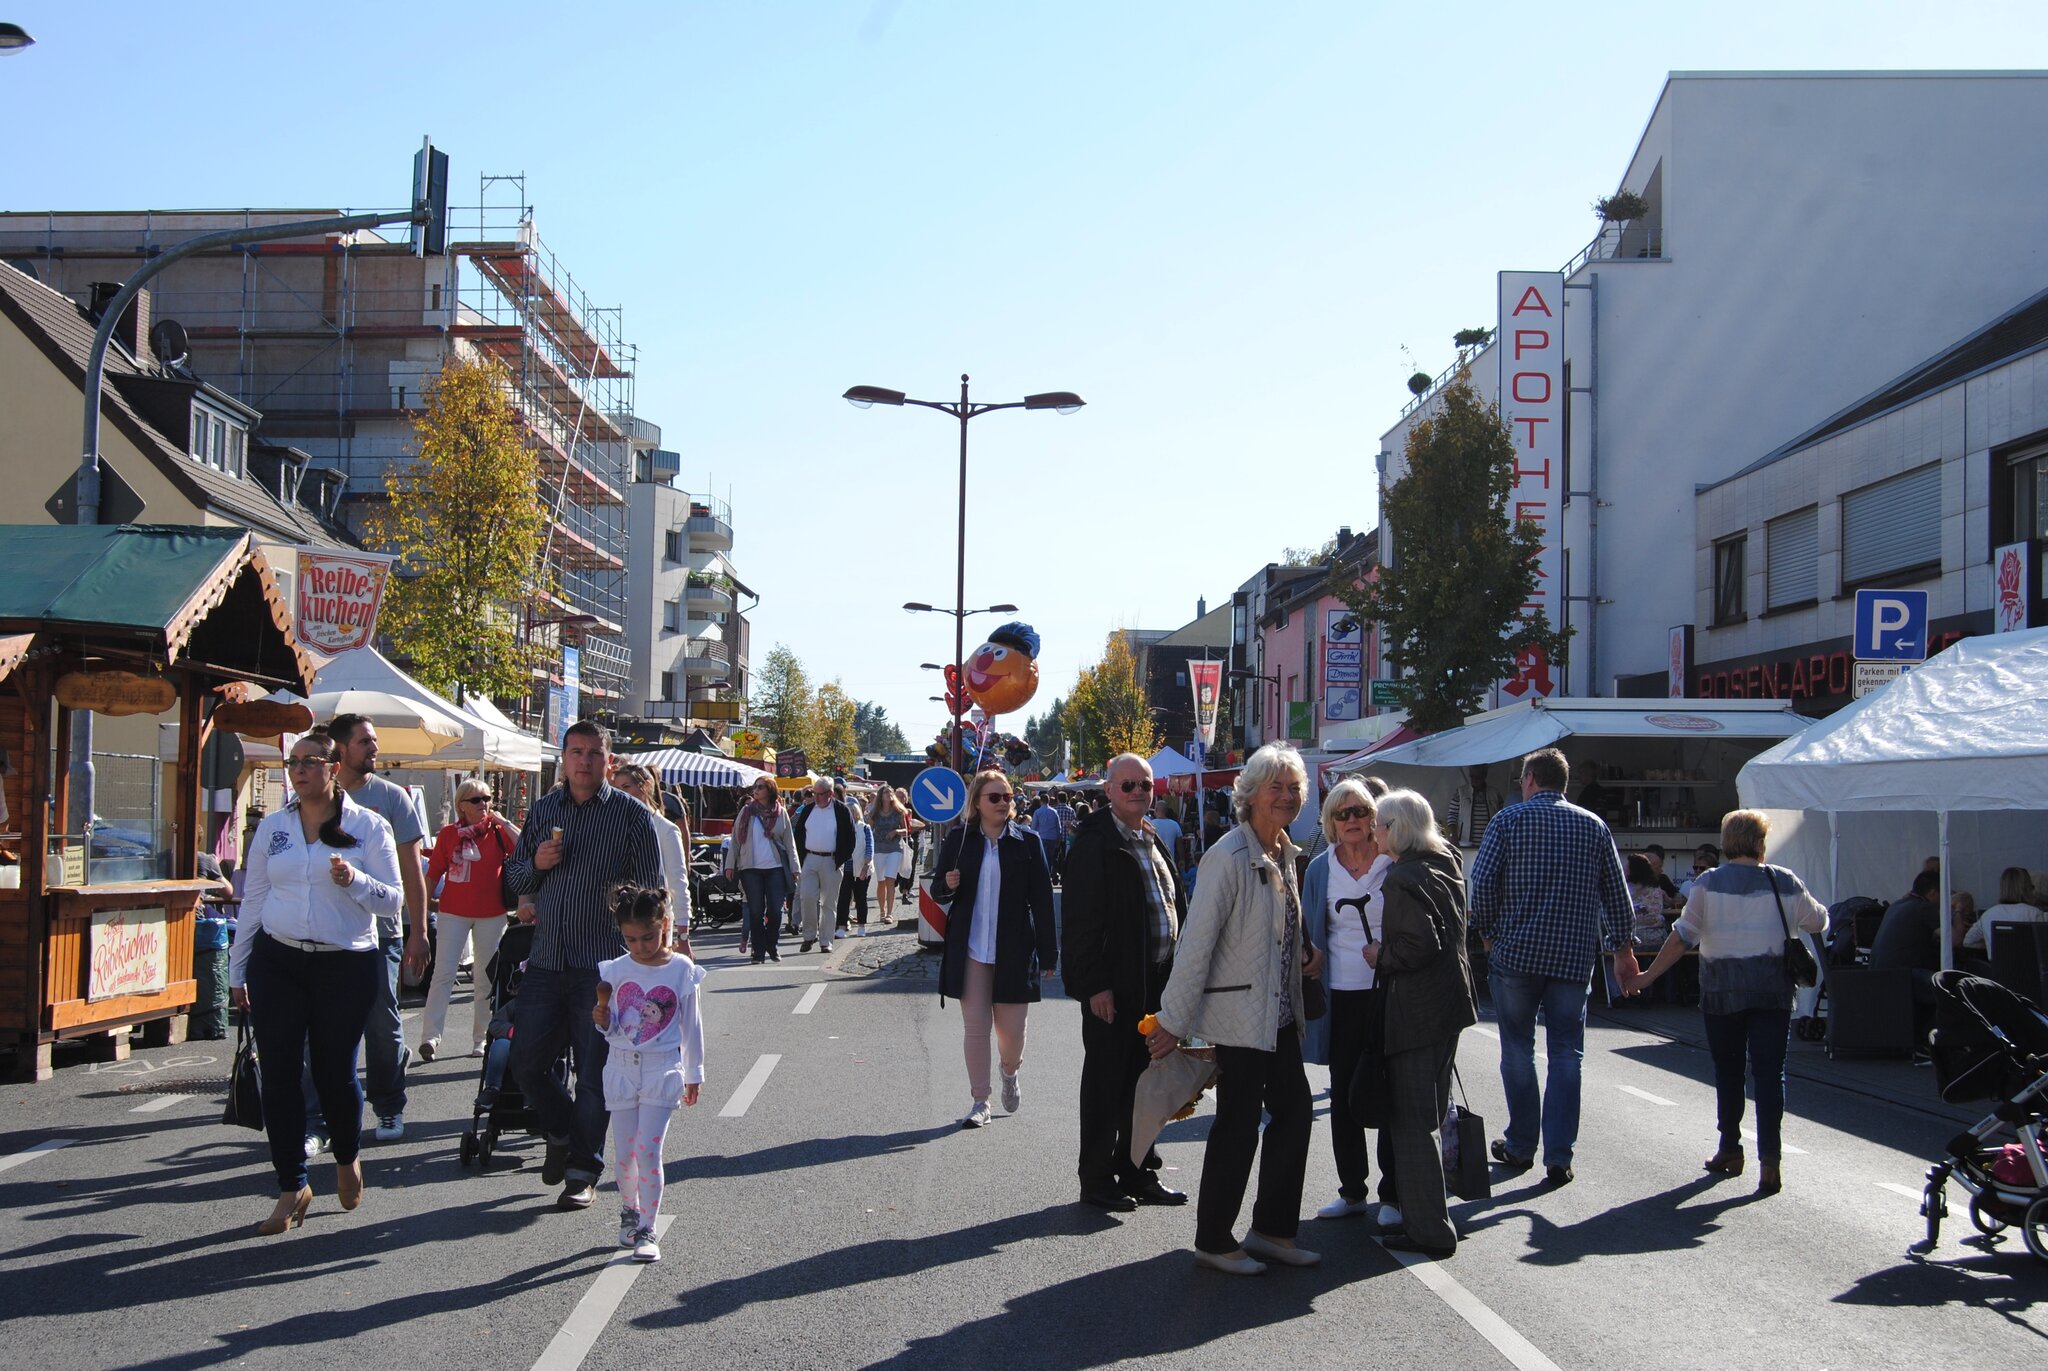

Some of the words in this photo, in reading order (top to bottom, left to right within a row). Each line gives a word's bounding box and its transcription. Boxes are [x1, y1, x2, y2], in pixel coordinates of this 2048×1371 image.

[309, 566, 374, 598] Reibe-
[1871, 599, 1910, 651] P
[1859, 667, 1885, 676] Parken
[1887, 667, 1900, 676] mit
